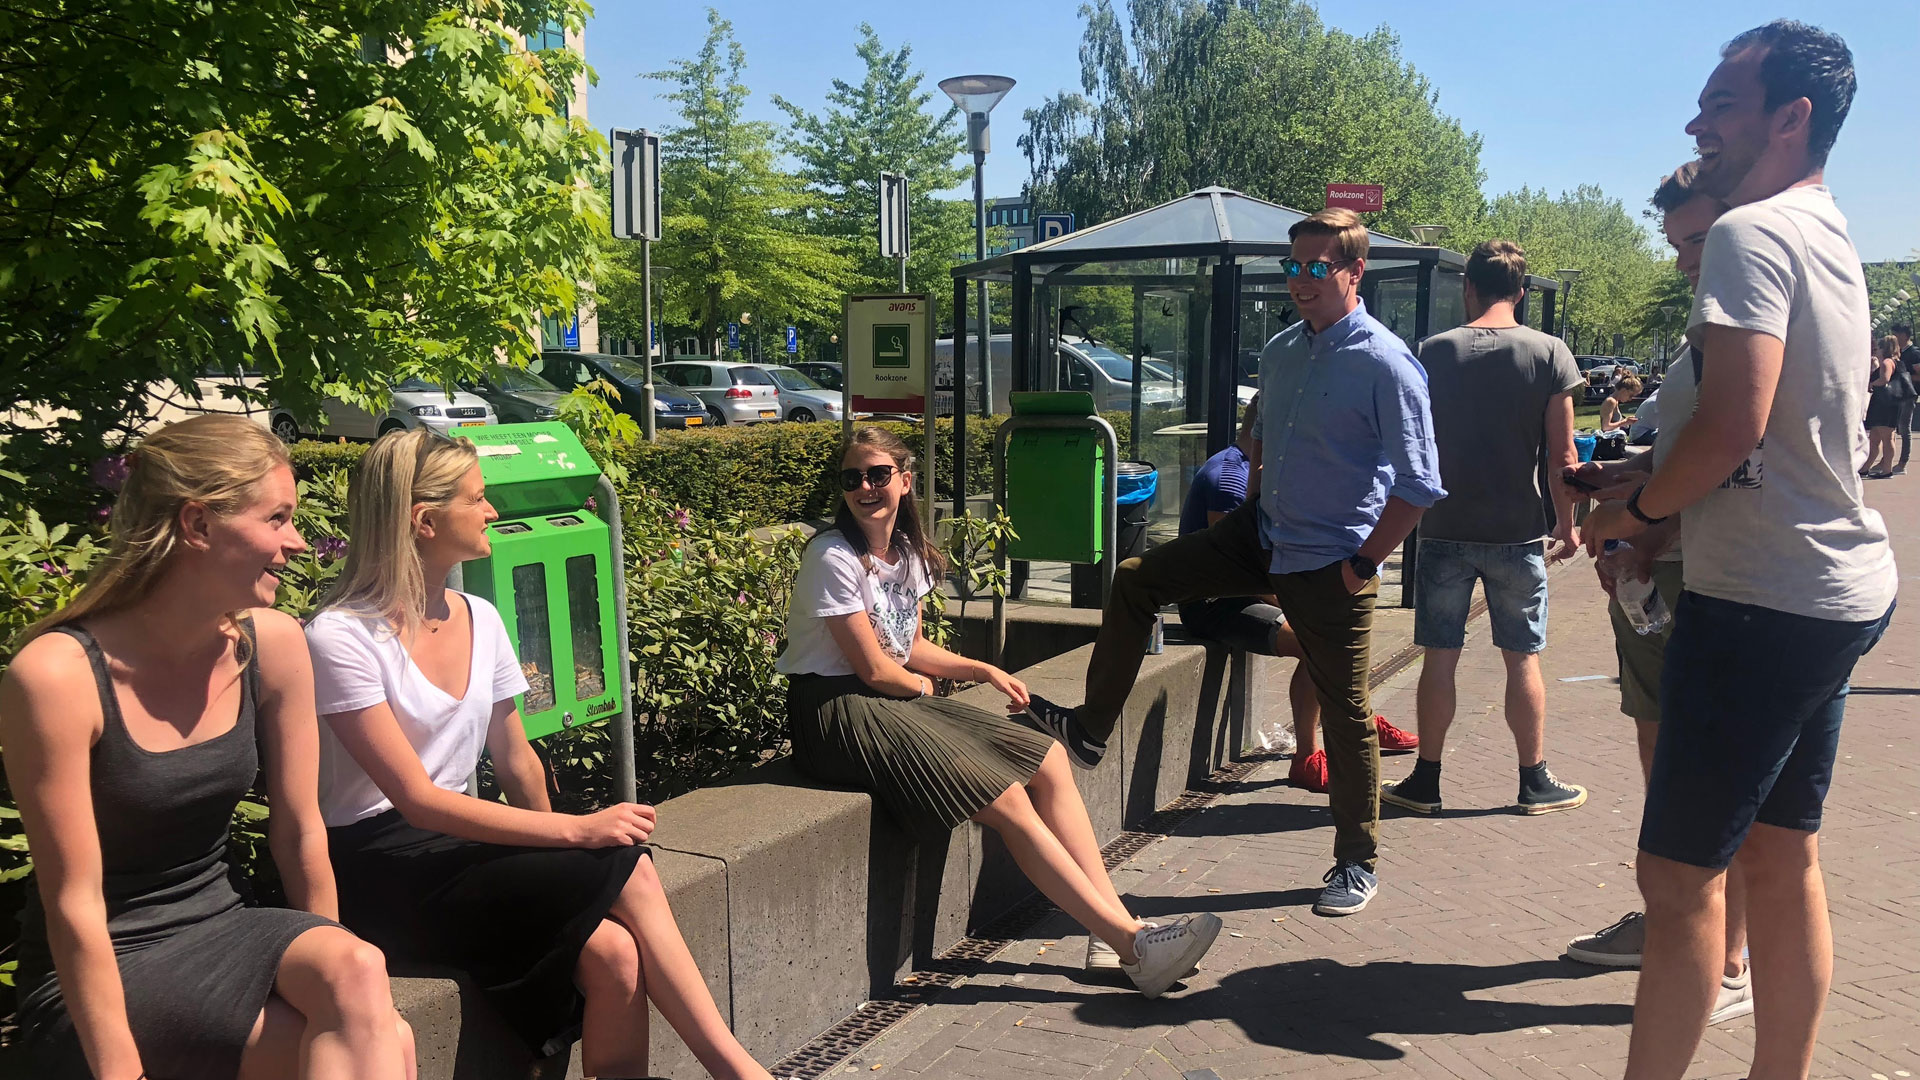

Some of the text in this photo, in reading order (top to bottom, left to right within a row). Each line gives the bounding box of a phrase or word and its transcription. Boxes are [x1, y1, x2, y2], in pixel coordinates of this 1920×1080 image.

[1330, 190, 1364, 199] Rookzone
[1045, 220, 1063, 241] P
[888, 302, 916, 311] avans
[732, 326, 736, 338] P
[790, 330, 794, 342] P
